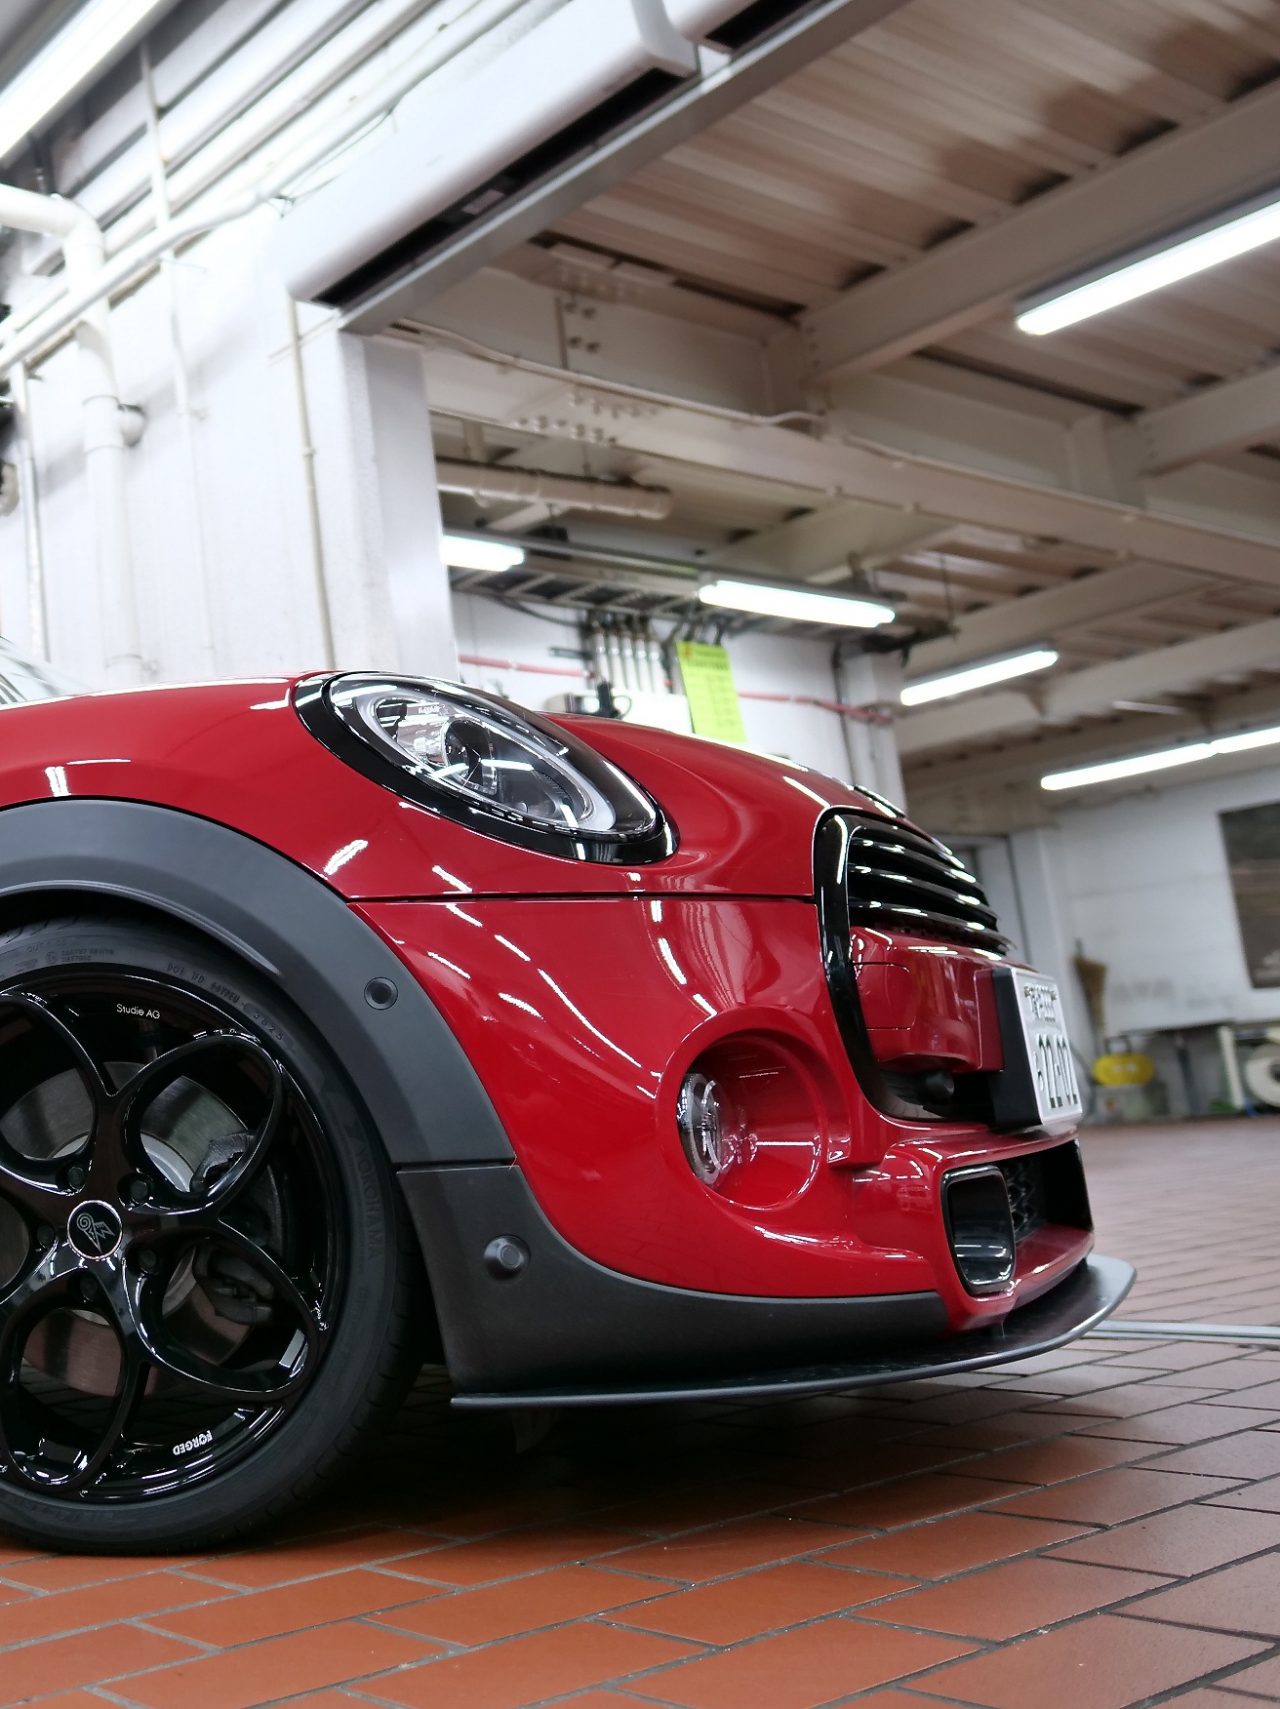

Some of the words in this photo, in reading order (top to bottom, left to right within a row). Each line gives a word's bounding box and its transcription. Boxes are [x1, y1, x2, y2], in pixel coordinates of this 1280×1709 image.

[116, 1003, 145, 1016] Studie
[146, 1009, 160, 1019] AG
[356, 1144, 386, 1262] YOKOHAMA
[172, 1430, 213, 1455] FORGED
